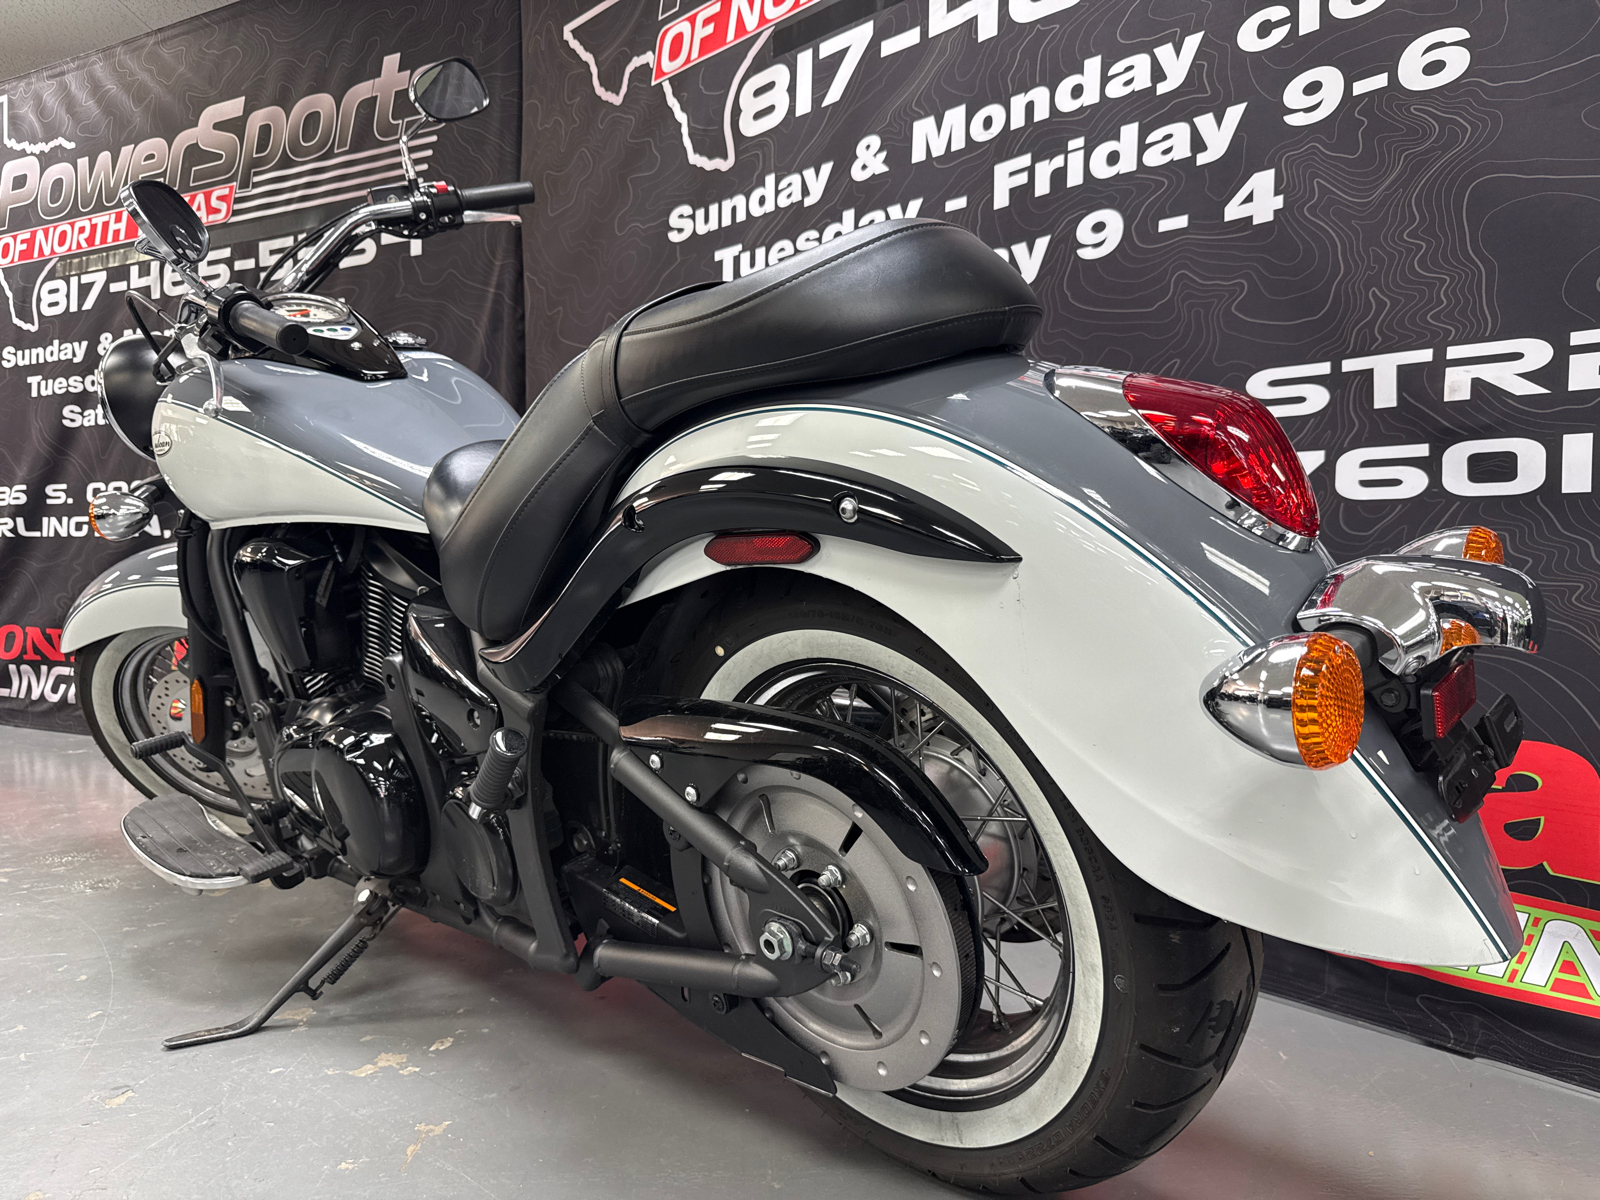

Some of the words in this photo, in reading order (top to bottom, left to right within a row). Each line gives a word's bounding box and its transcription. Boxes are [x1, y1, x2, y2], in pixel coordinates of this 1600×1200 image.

[660, 1, 722, 74] OF
[667, 160, 834, 243] Sunday
[850, 133, 890, 182] &
[911, 30, 1206, 165] Monday
[944, 194, 968, 213] -
[993, 103, 1248, 211] Friday
[1282, 27, 1473, 126] 9-6
[0, 232, 31, 265] OF
[33, 210, 128, 258] NORTH
[1076, 208, 1125, 260] 9
[1158, 214, 1189, 233] -
[1224, 168, 1285, 226] 4
[1, 339, 89, 369] Sunday
[44, 483, 74, 505] S.
